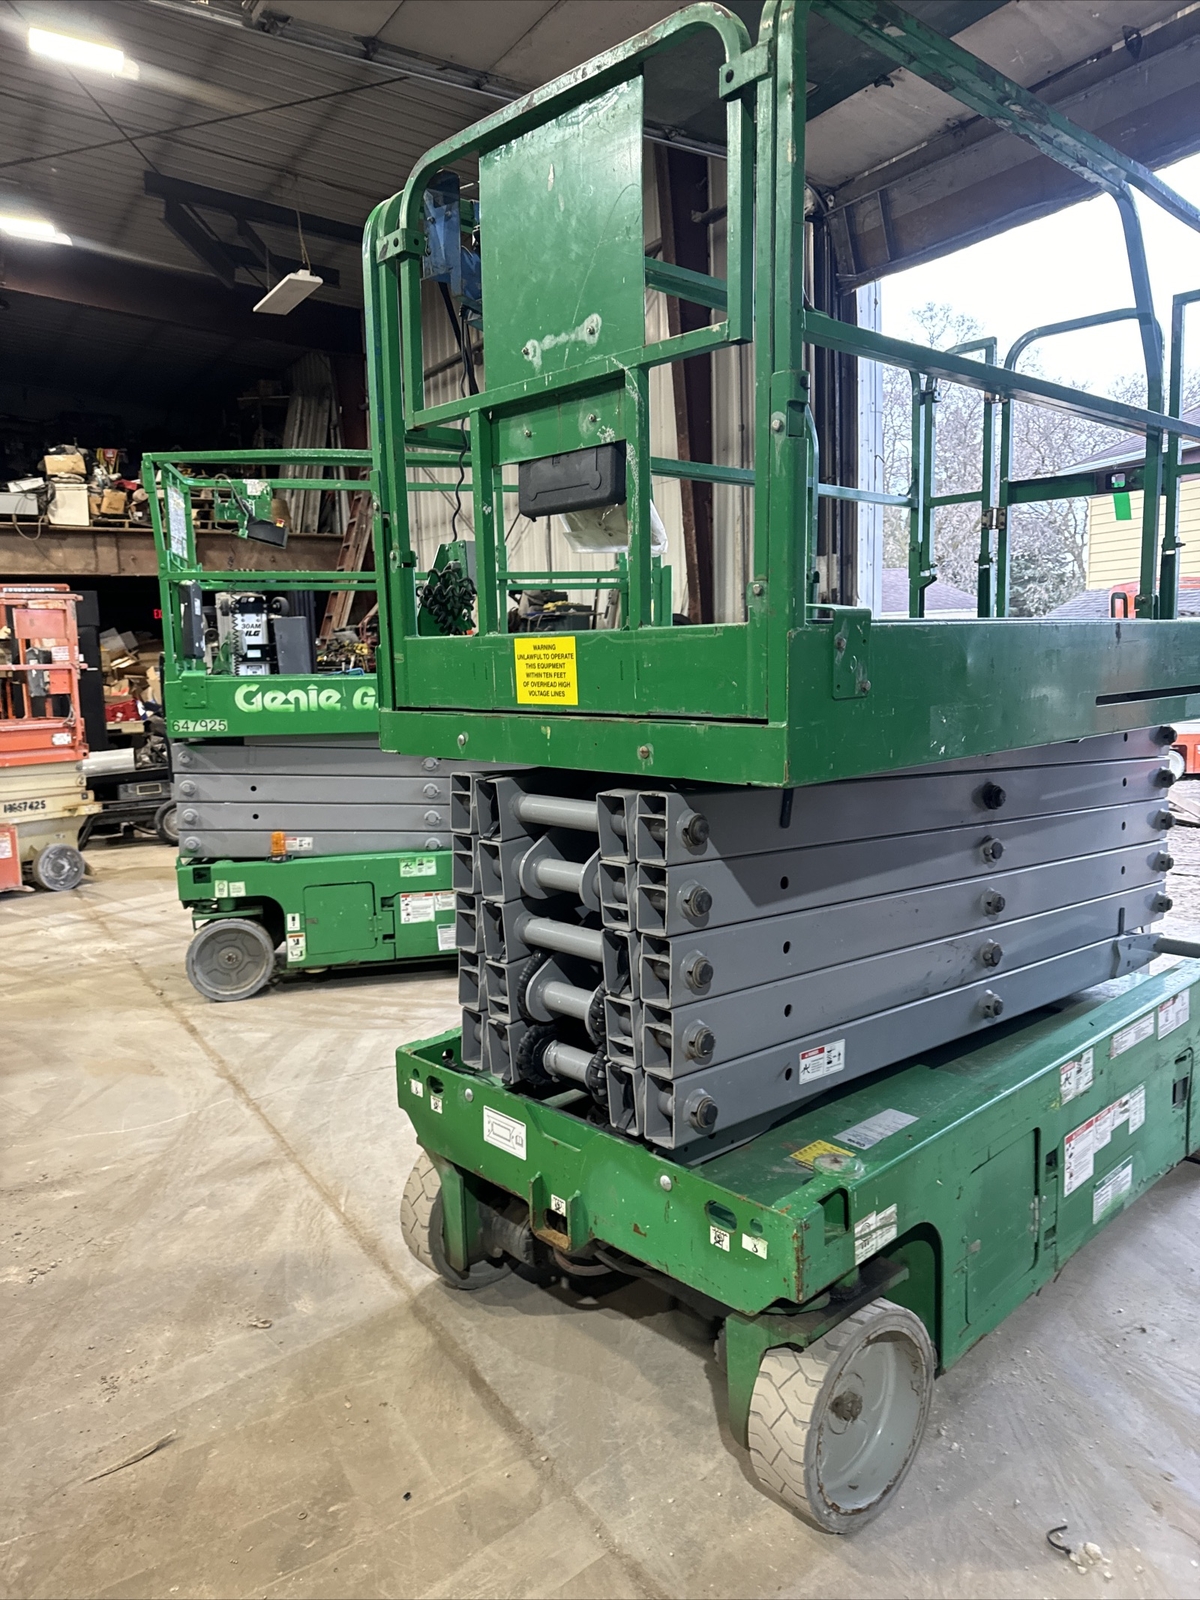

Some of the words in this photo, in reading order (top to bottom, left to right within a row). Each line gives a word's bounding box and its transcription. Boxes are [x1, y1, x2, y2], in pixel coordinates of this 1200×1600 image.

[234, 683, 341, 713] Genie
[352, 686, 379, 711] G
[171, 719, 227, 732] 647925
